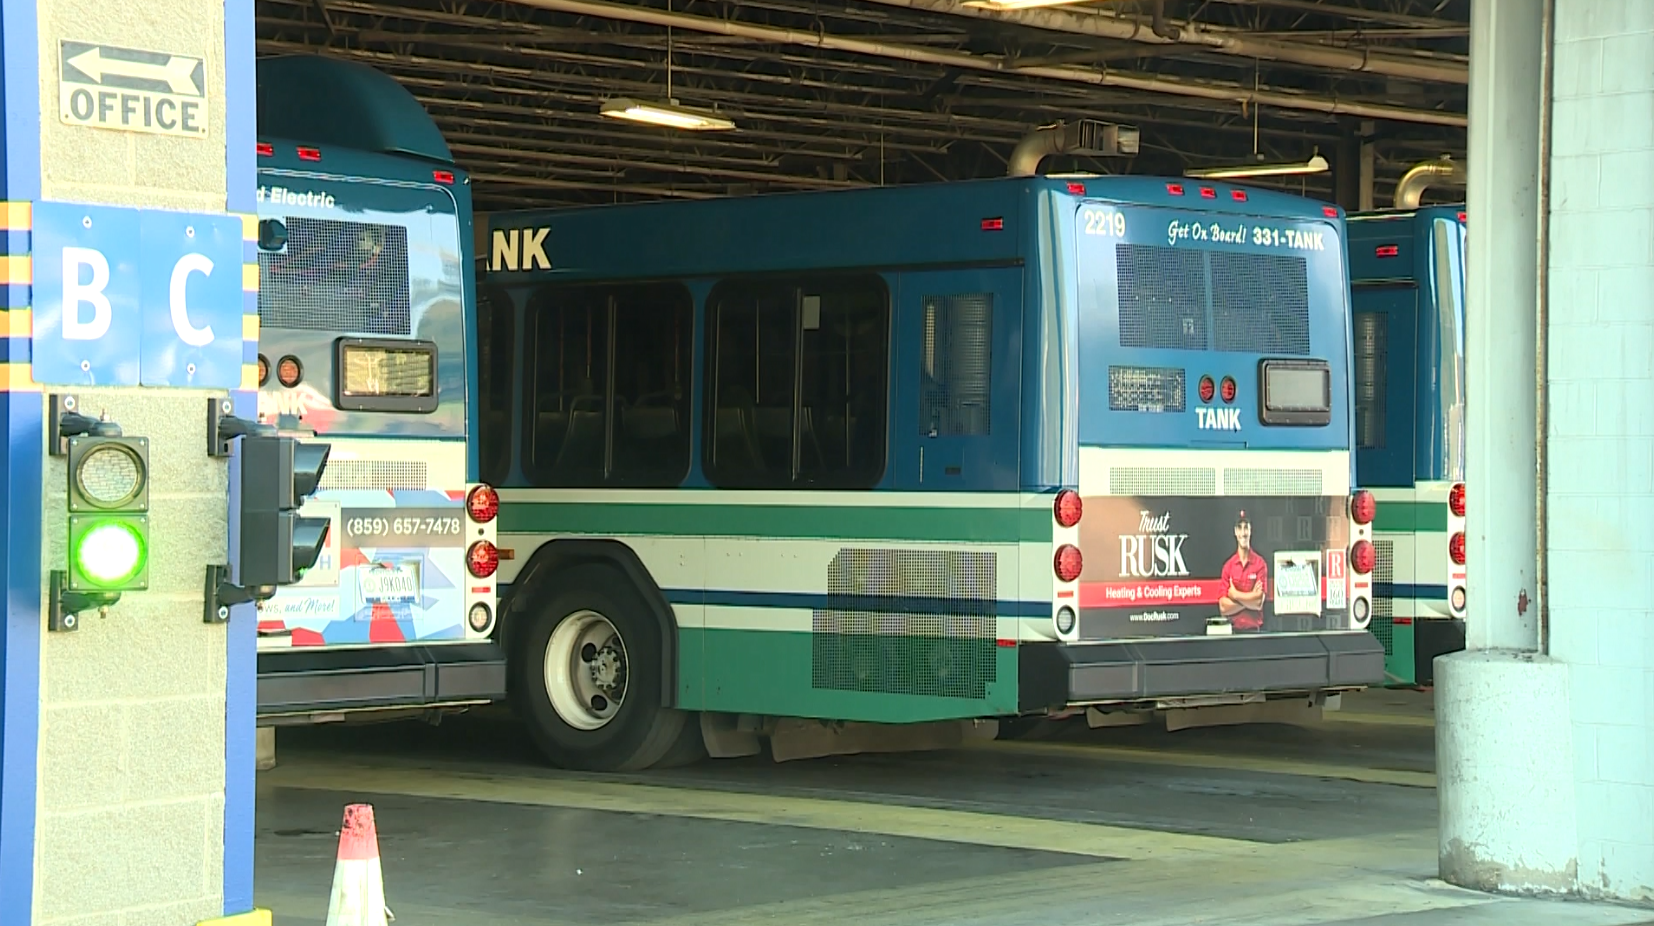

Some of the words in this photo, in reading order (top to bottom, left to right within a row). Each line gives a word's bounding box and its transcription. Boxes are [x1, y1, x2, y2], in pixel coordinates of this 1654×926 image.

[70, 88, 199, 132] OFFICE
[270, 187, 335, 209] Electric
[1084, 210, 1125, 237] 2219
[1168, 219, 1189, 245] Get
[1192, 221, 1207, 241] On
[1210, 223, 1246, 244] Board!
[1253, 227, 1324, 251] 331-TANK
[486, 228, 551, 271] NK
[62, 246, 112, 340] B
[169, 252, 215, 347] C
[1195, 407, 1241, 430] TANK
[347, 518, 389, 537] (859)
[393, 518, 460, 535] 657-7478
[1139, 510, 1170, 532] Trust
[1119, 534, 1190, 577] RUSK
[1330, 553, 1342, 577] R
[1105, 586, 1135, 601] Heating
[1137, 586, 1142, 598] &
[1144, 585, 1172, 600] Cooling
[1174, 585, 1202, 599] Experts
[285, 600, 303, 613] and
[304, 598, 335, 614] More!
[1129, 610, 1179, 621] www.DocRusk.com
